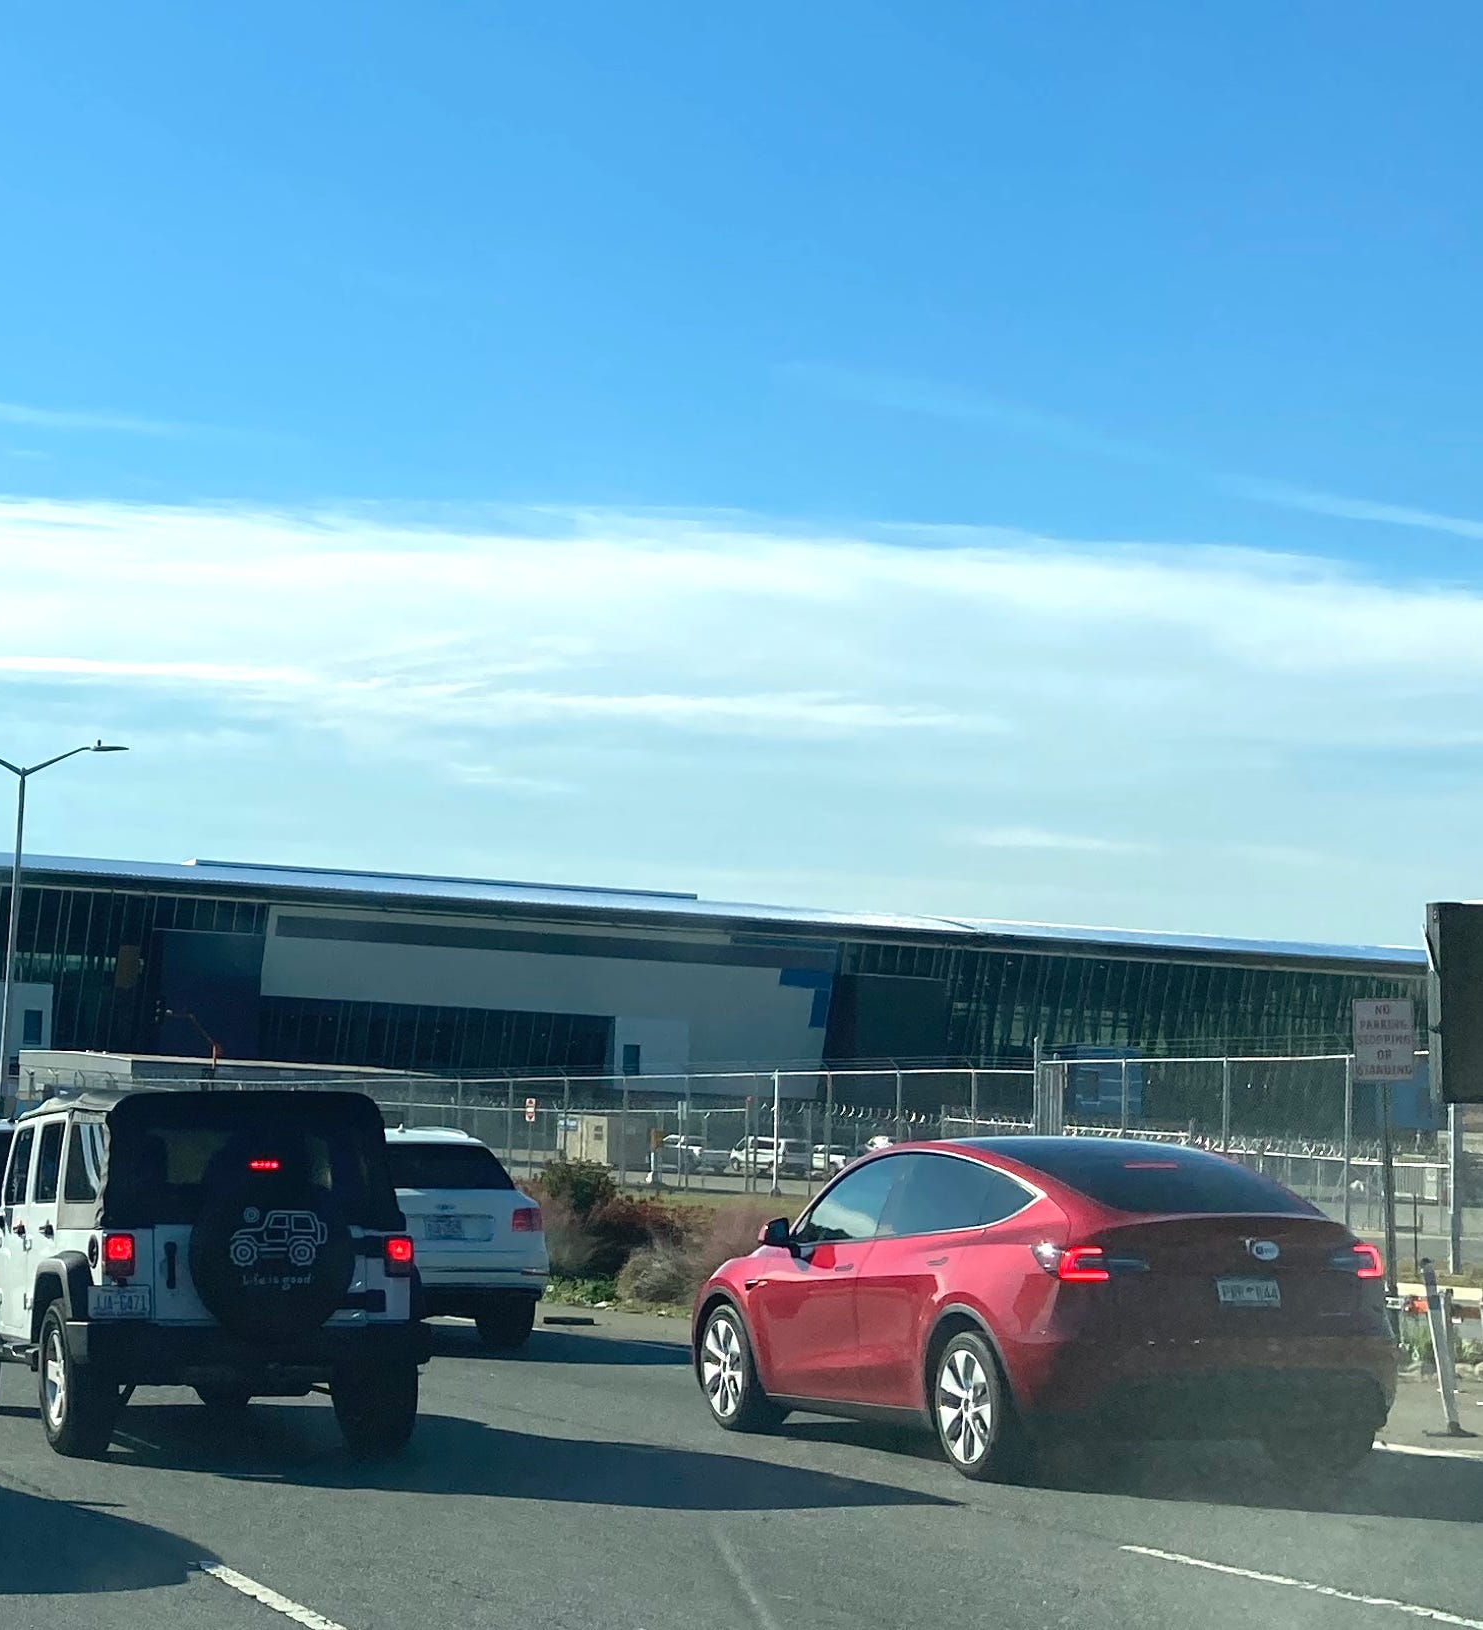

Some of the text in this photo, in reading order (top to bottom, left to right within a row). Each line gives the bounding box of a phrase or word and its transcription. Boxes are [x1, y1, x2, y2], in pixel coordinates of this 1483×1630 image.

[1374, 1004, 1390, 1015] NO
[1377, 1048, 1392, 1060] OR
[281, 1271, 312, 1291] good
